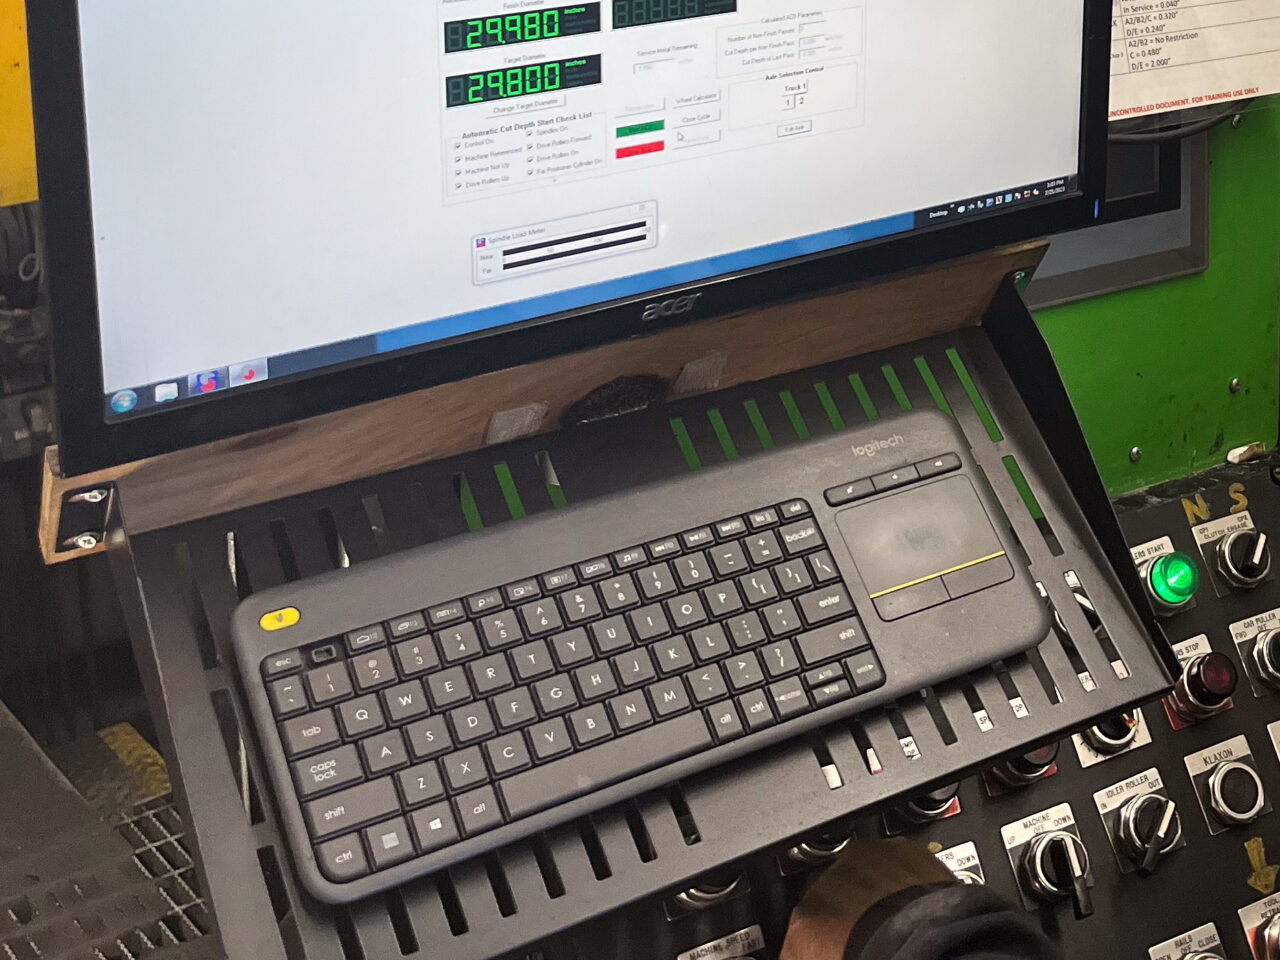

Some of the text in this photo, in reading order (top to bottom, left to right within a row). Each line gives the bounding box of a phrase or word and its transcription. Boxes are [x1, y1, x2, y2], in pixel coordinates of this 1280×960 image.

[1131, 2, 1153, 12] Service
[1125, 15, 1152, 25] A2/B2/C
[467, 10, 559, 49] 29.980
[1127, 28, 1139, 36] D/E
[1128, 39, 1148, 48] A2/B2
[1166, 32, 1199, 43] Restriction
[1131, 61, 1143, 70] D/E
[469, 63, 559, 102] 29.800
[1192, 96, 1203, 104] FOR
[1205, 91, 1232, 101] TRAINING
[1244, 87, 1259, 95] ONLY
[462, 128, 498, 139] Automatic
[514, 123, 535, 131] Depth
[537, 118, 554, 127] Start
[556, 114, 576, 123] Check
[641, 293, 702, 321] acer
[851, 434, 905, 457] logitech
[1181, 483, 1248, 525] N S
[1147, 544, 1165, 556] START
[819, 595, 840, 608] enter
[1243, 613, 1276, 629] CAR PULLER
[839, 629, 856, 640] shift
[1185, 643, 1199, 654] STOP
[275, 657, 292, 667] esc
[751, 701, 764, 713] ctrl
[720, 714, 732, 724] alt
[302, 725, 321, 738] tab
[1203, 748, 1234, 766] KLAXON
[310, 759, 337, 774] caps
[313, 769, 337, 782] lock
[1106, 774, 1149, 799] IDLER ROLLER
[1148, 778, 1161, 790] OUT
[324, 806, 345, 820] shift
[473, 802, 486, 815] alt
[1022, 813, 1051, 829] MACHINE
[1054, 815, 1071, 827] DOWN
[1034, 825, 1045, 834] OFF
[1007, 835, 1015, 845] UP
[335, 850, 353, 863] ctrl
[956, 854, 976, 868] DOWN
[1263, 897, 1280, 909] TOOL
[689, 931, 750, 960] MACHINE SPEED
[1198, 933, 1217, 949] CLOSE
